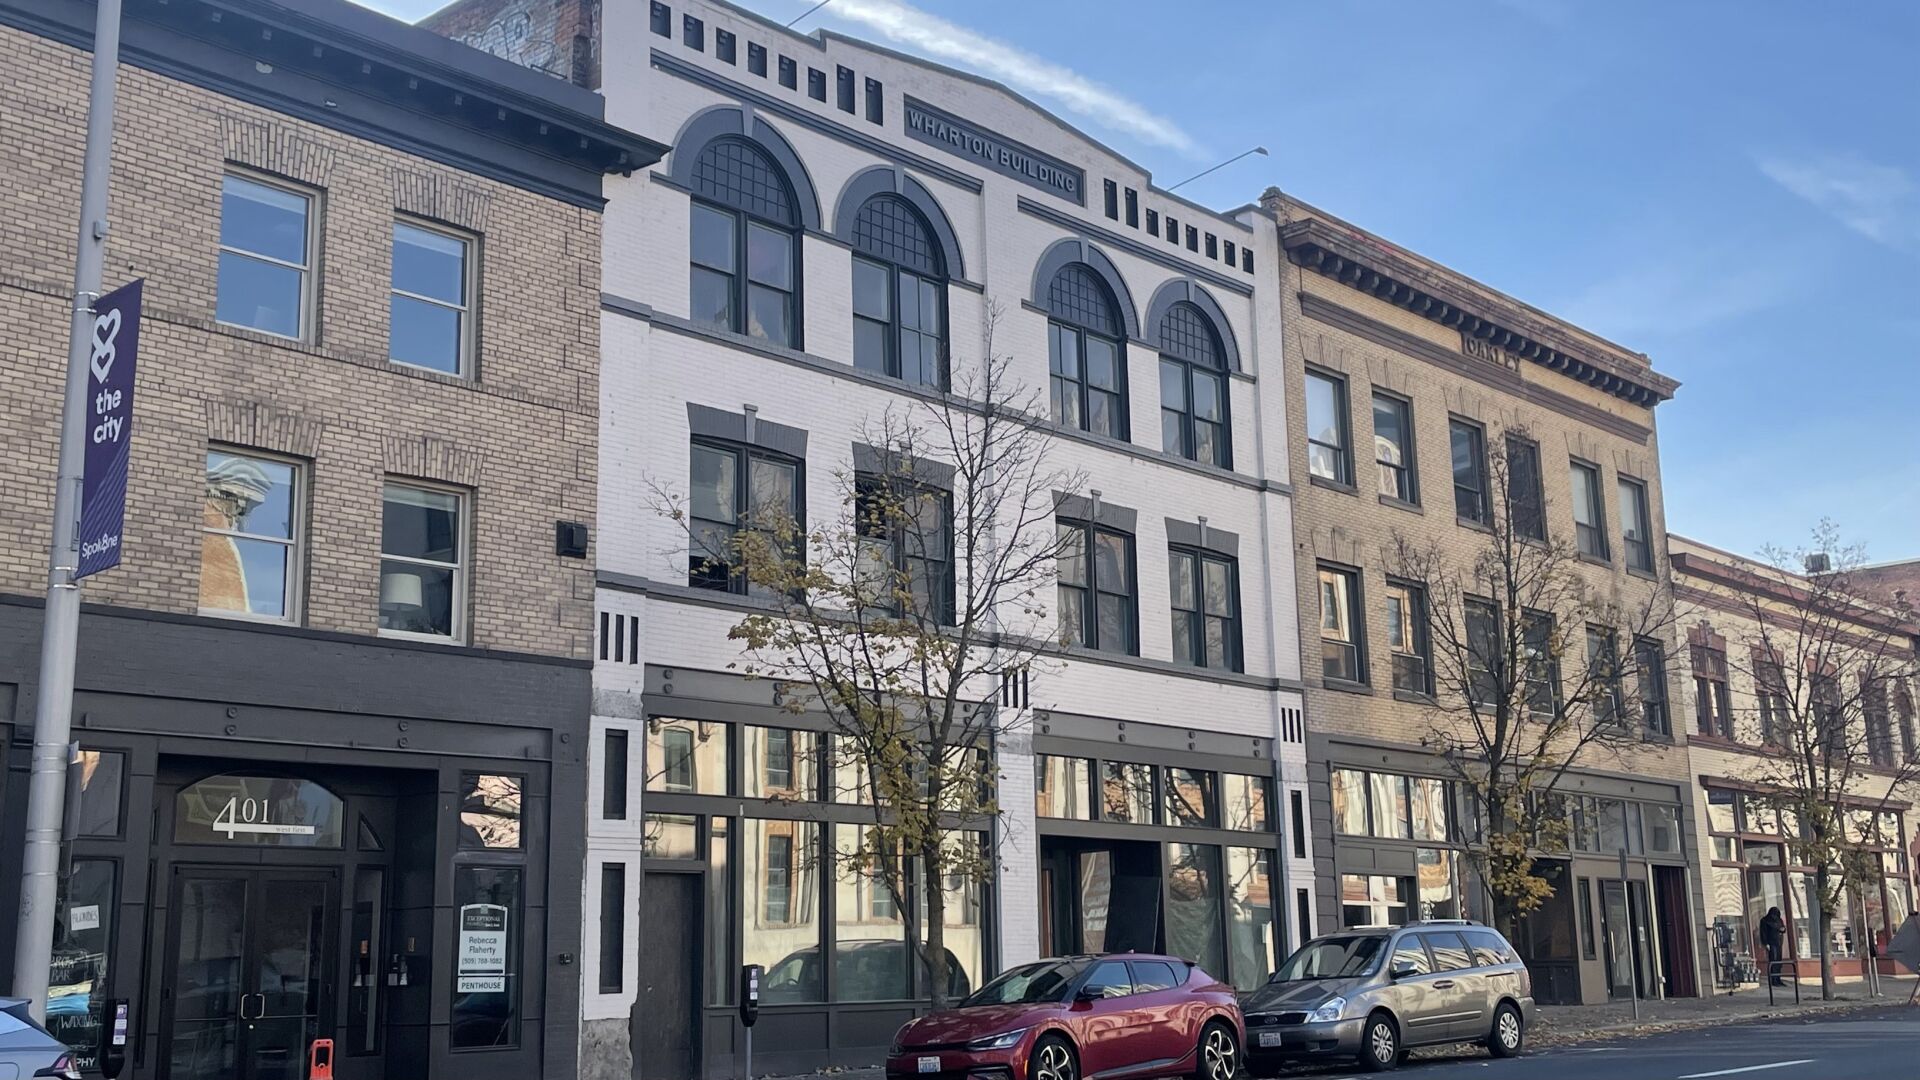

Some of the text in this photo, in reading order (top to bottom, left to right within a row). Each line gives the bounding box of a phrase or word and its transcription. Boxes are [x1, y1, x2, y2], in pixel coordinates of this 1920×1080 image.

[909, 110, 1075, 192] WHARTON BUILDING
[1466, 337, 1520, 373] OAKLEY
[96, 388, 122, 415] the
[93, 415, 124, 444] city
[212, 797, 269, 840] 401
[469, 936, 497, 944] Rebecca
[469, 946, 496, 955] Flaherty
[461, 981, 502, 990] PENTHOUSE
[61, 1015, 98, 1029] WAXING
